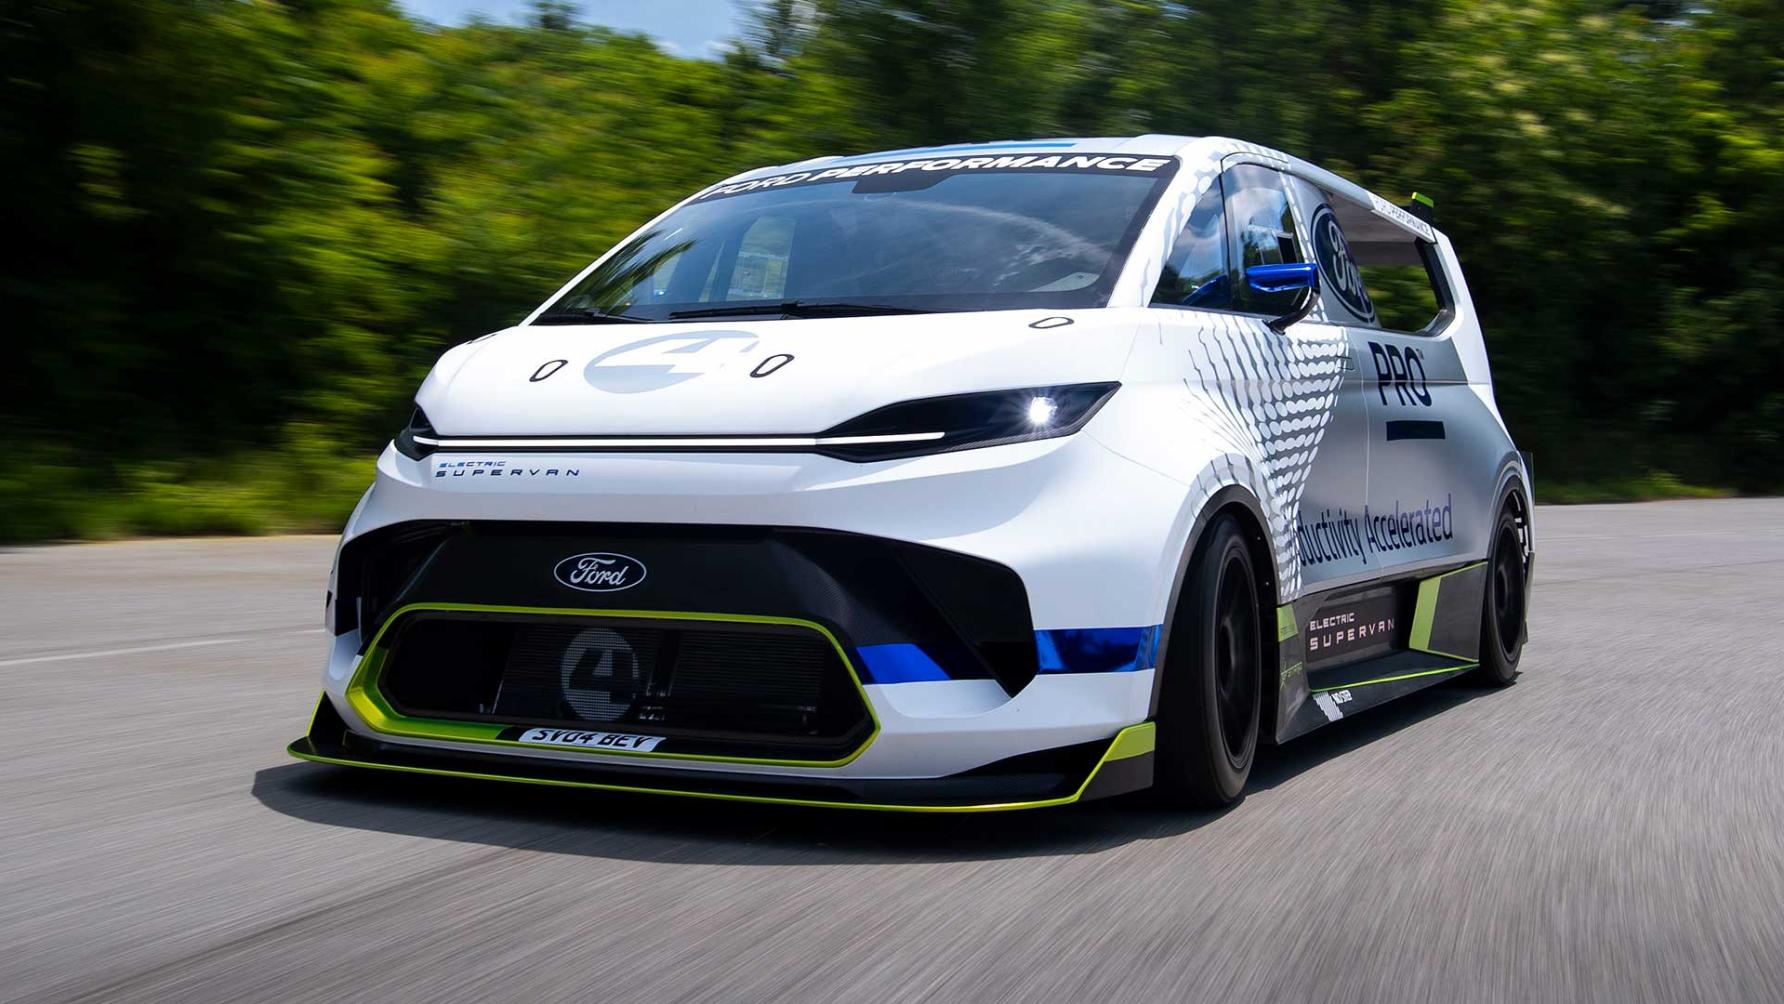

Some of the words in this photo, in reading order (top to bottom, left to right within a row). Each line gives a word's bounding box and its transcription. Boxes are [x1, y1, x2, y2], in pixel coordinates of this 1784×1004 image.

[699, 172, 813, 200] FORD
[807, 156, 1172, 182] PERFORMANCE
[1368, 341, 1432, 406] PRO
[435, 469, 579, 477] SUPERVAN
[1364, 493, 1453, 553] Accelerated
[570, 557, 629, 585] Ford
[1309, 612, 1355, 631] ELECTRIC
[1309, 618, 1395, 650] SUPERVAN
[568, 648, 640, 705] 4
[532, 729, 595, 743] SV04
[597, 734, 653, 748] BEV
